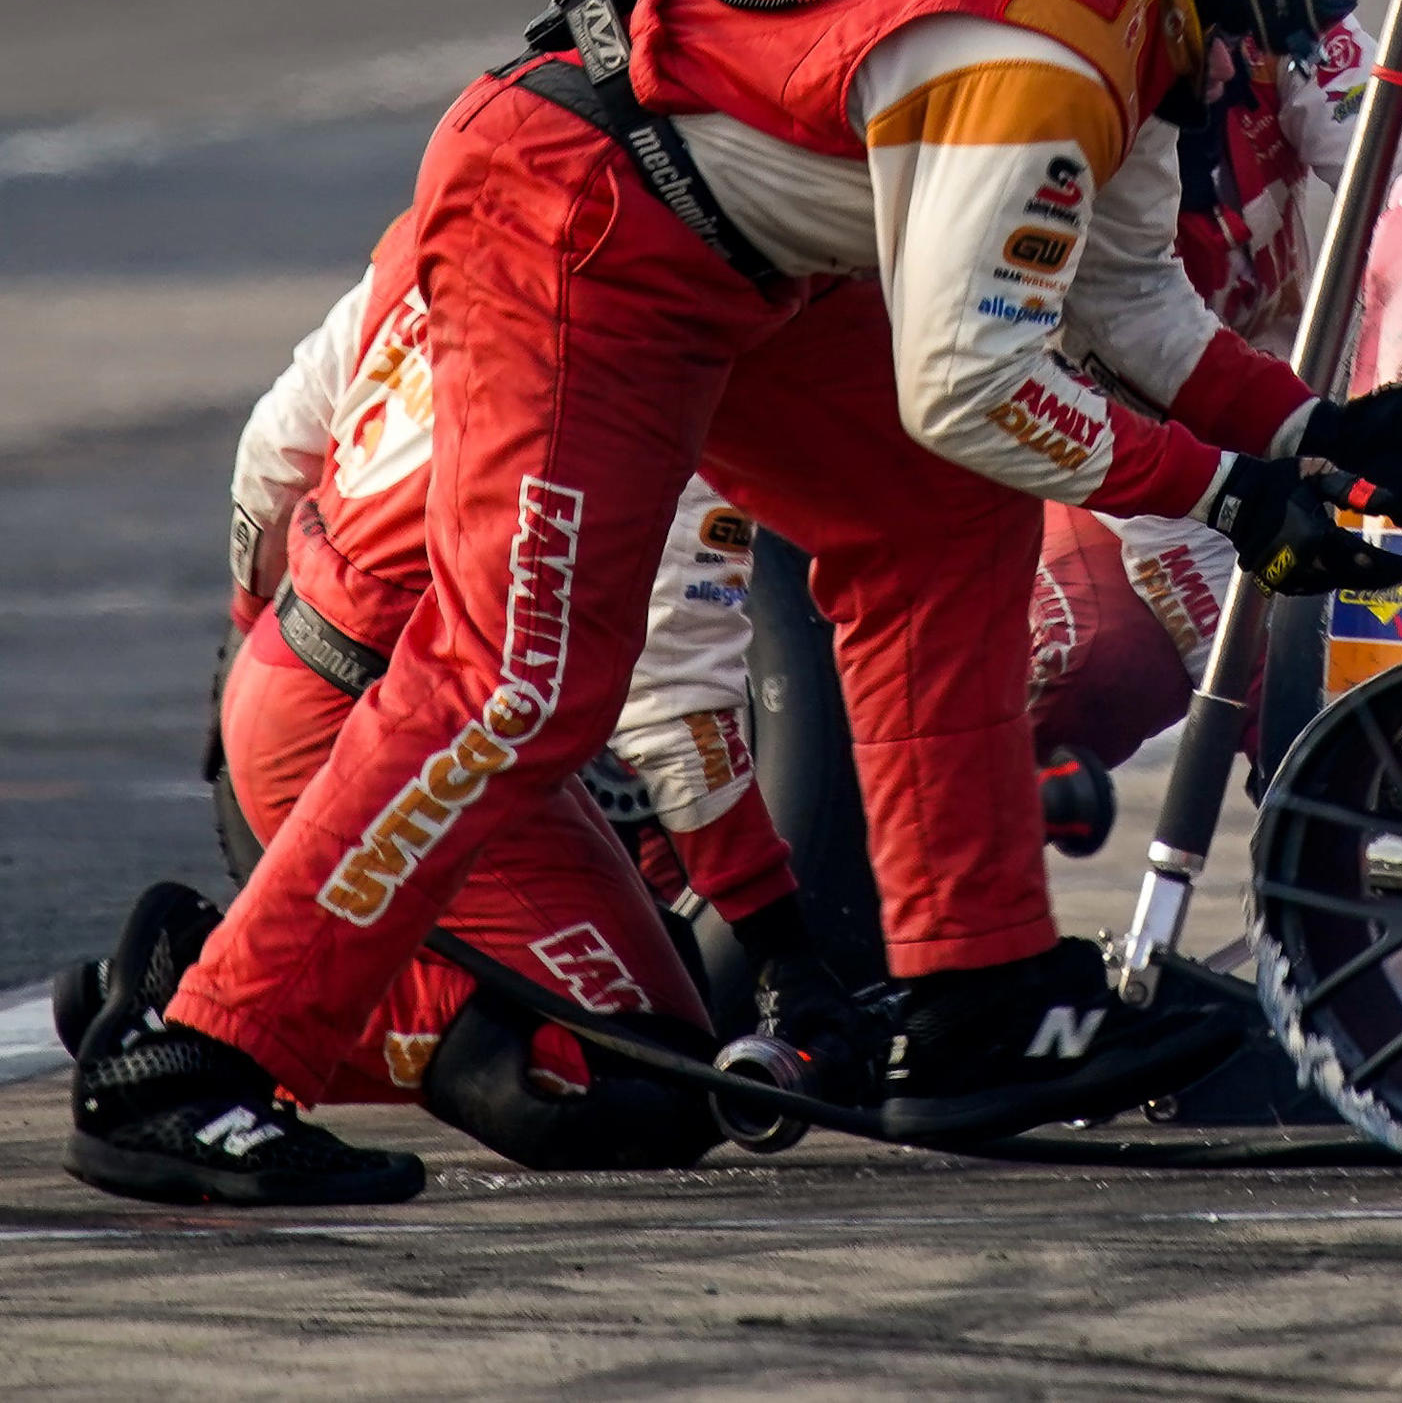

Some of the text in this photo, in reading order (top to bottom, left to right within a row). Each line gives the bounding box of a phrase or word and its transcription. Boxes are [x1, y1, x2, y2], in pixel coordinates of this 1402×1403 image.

[501, 474, 585, 716] FAMILY
[317, 719, 518, 928] DOLLAR
[1023, 1006, 1108, 1059] N
